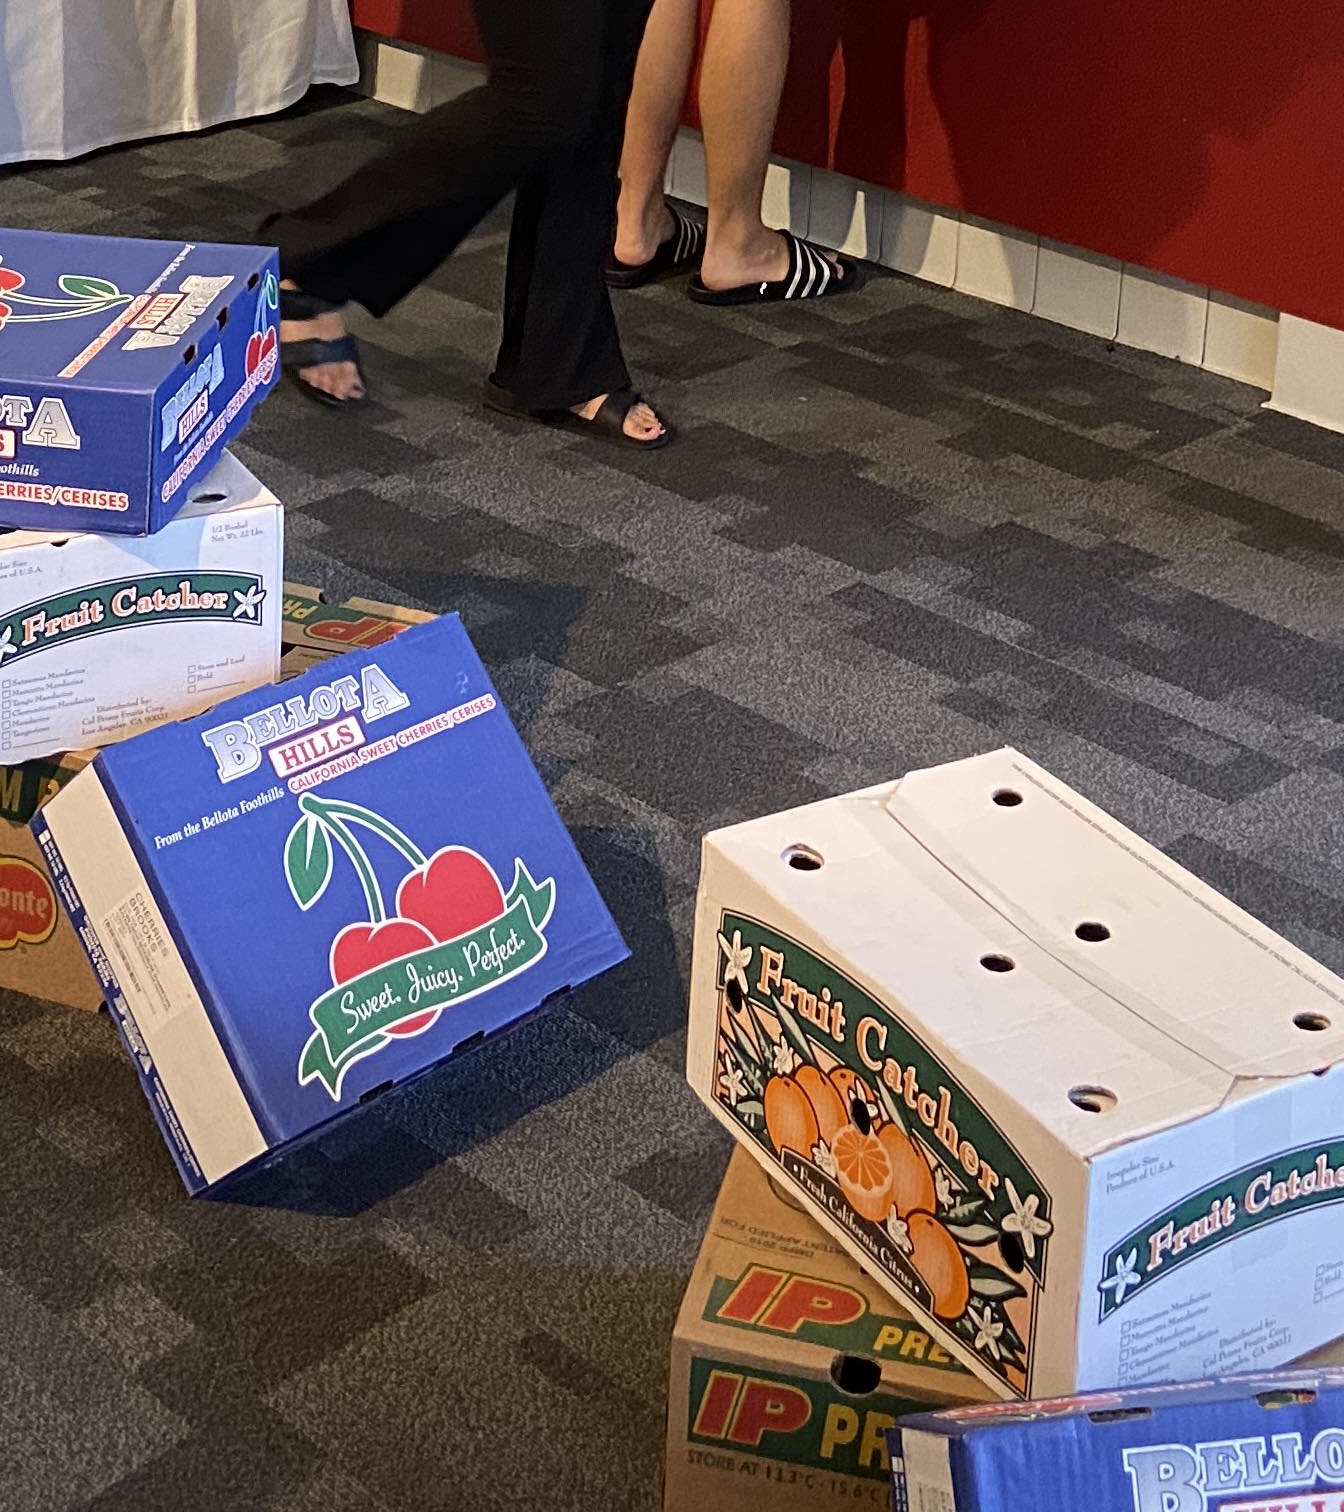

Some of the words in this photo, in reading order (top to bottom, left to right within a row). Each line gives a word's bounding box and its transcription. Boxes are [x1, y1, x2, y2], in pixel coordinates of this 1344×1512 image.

[181, 396, 206, 438] HILLS
[21, 599, 104, 646] Fruit
[110, 581, 229, 617] Catcher
[201, 663, 410, 784] BELLOTA
[278, 724, 355, 770] HILLS
[290, 753, 358, 791] CALIFORNIA
[361, 738, 396, 762] SWEET
[399, 696, 494, 745] CHERRIES/CERISES
[154, 830, 183, 849] From
[183, 821, 201, 837] the
[201, 807, 239, 830] Bellota
[240, 786, 285, 814] Foothills
[128, 897, 158, 953] BROOKS
[135, 891, 170, 958] CHERRIES
[340, 982, 401, 1034] Sweet.
[406, 963, 464, 1003] Juicy.
[462, 927, 525, 977] Perfect.
[756, 946, 845, 1042] Fruit
[856, 1016, 999, 1200] Catcher
[800, 1166, 827, 1203] Fresh
[829, 1197, 879, 1256] California
[881, 1247, 913, 1288] Citrus
[1146, 1196, 1236, 1272] Fruit
[716, 1262, 869, 1333] IP
[692, 1369, 812, 1446] IP
[687, 1449, 735, 1472] STORE
[739, 1462, 759, 1476] AT
